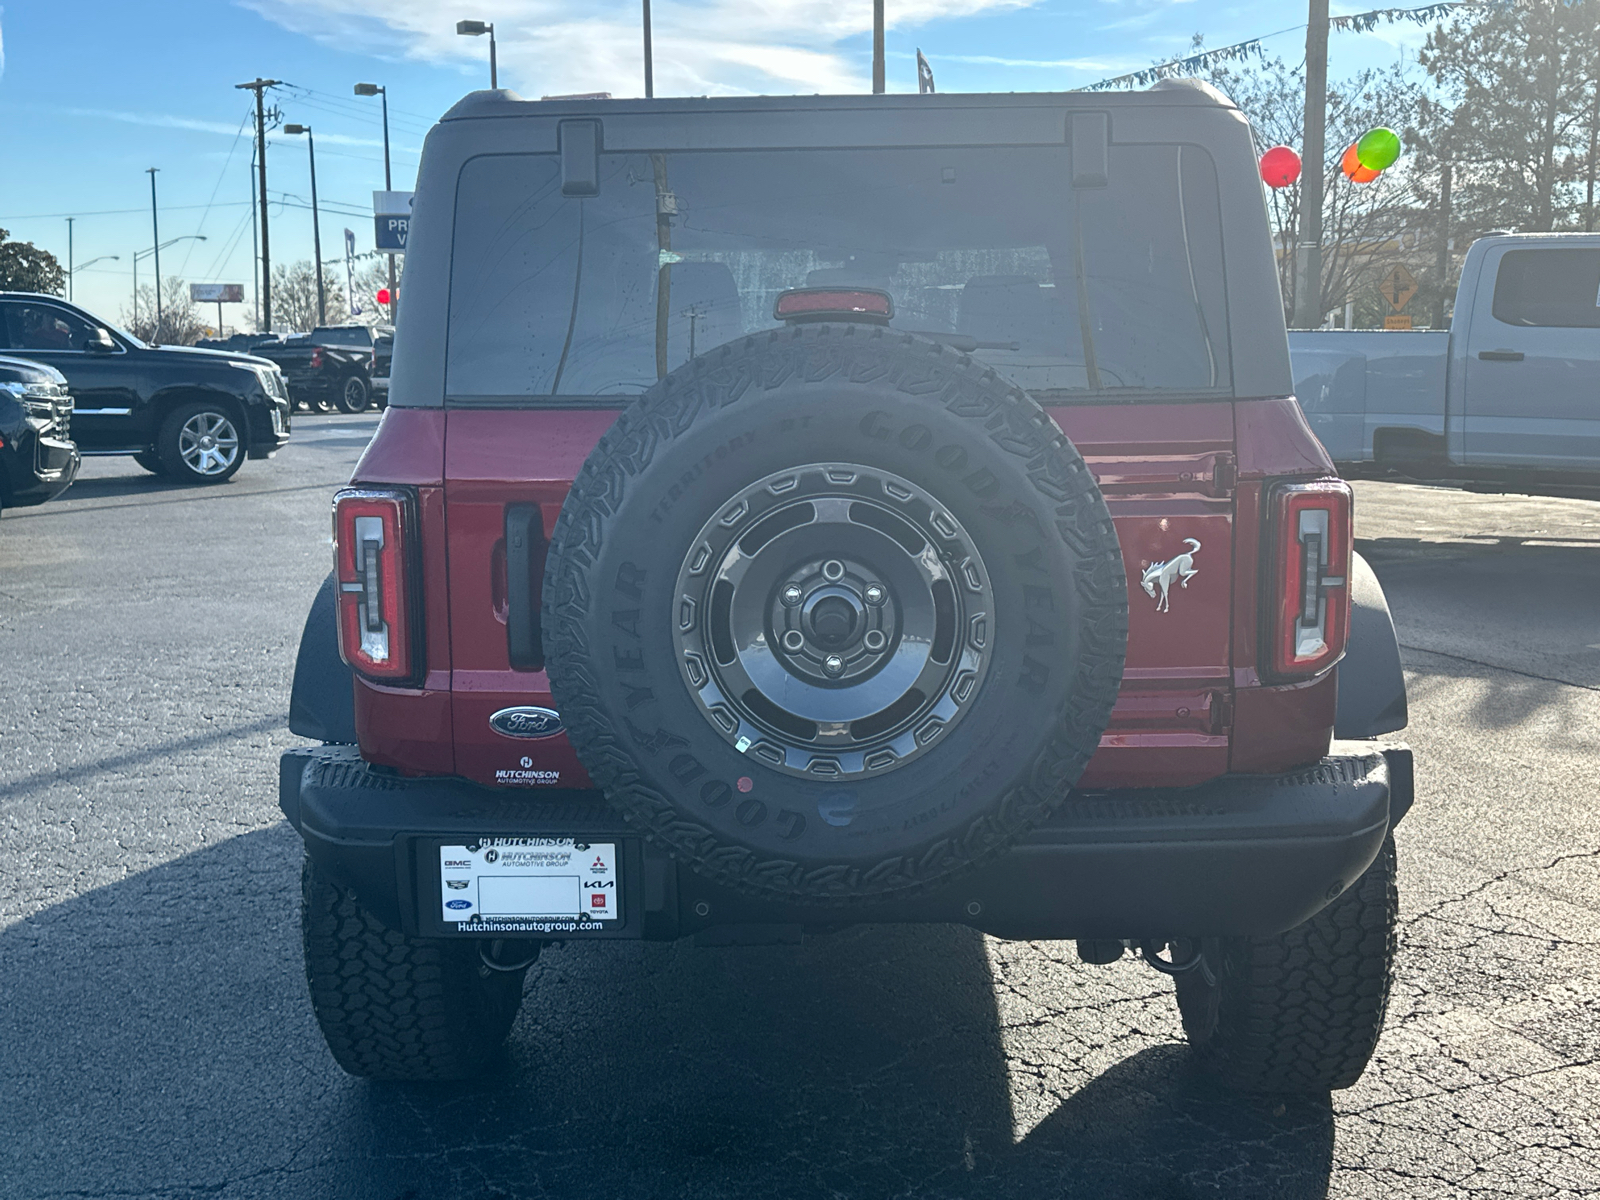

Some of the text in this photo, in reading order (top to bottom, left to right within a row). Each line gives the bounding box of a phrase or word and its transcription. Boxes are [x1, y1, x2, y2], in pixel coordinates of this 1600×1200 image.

[650, 429, 756, 524] TERRITORY
[507, 713, 548, 730] Ford
[496, 770, 559, 778] HUTCHINSON
[494, 837, 575, 848] HUTCHINSON
[501, 852, 572, 862] HUTCHINSON
[584, 880, 614, 889] KIA
[458, 921, 603, 932] Hutchinsonautogroup.com
